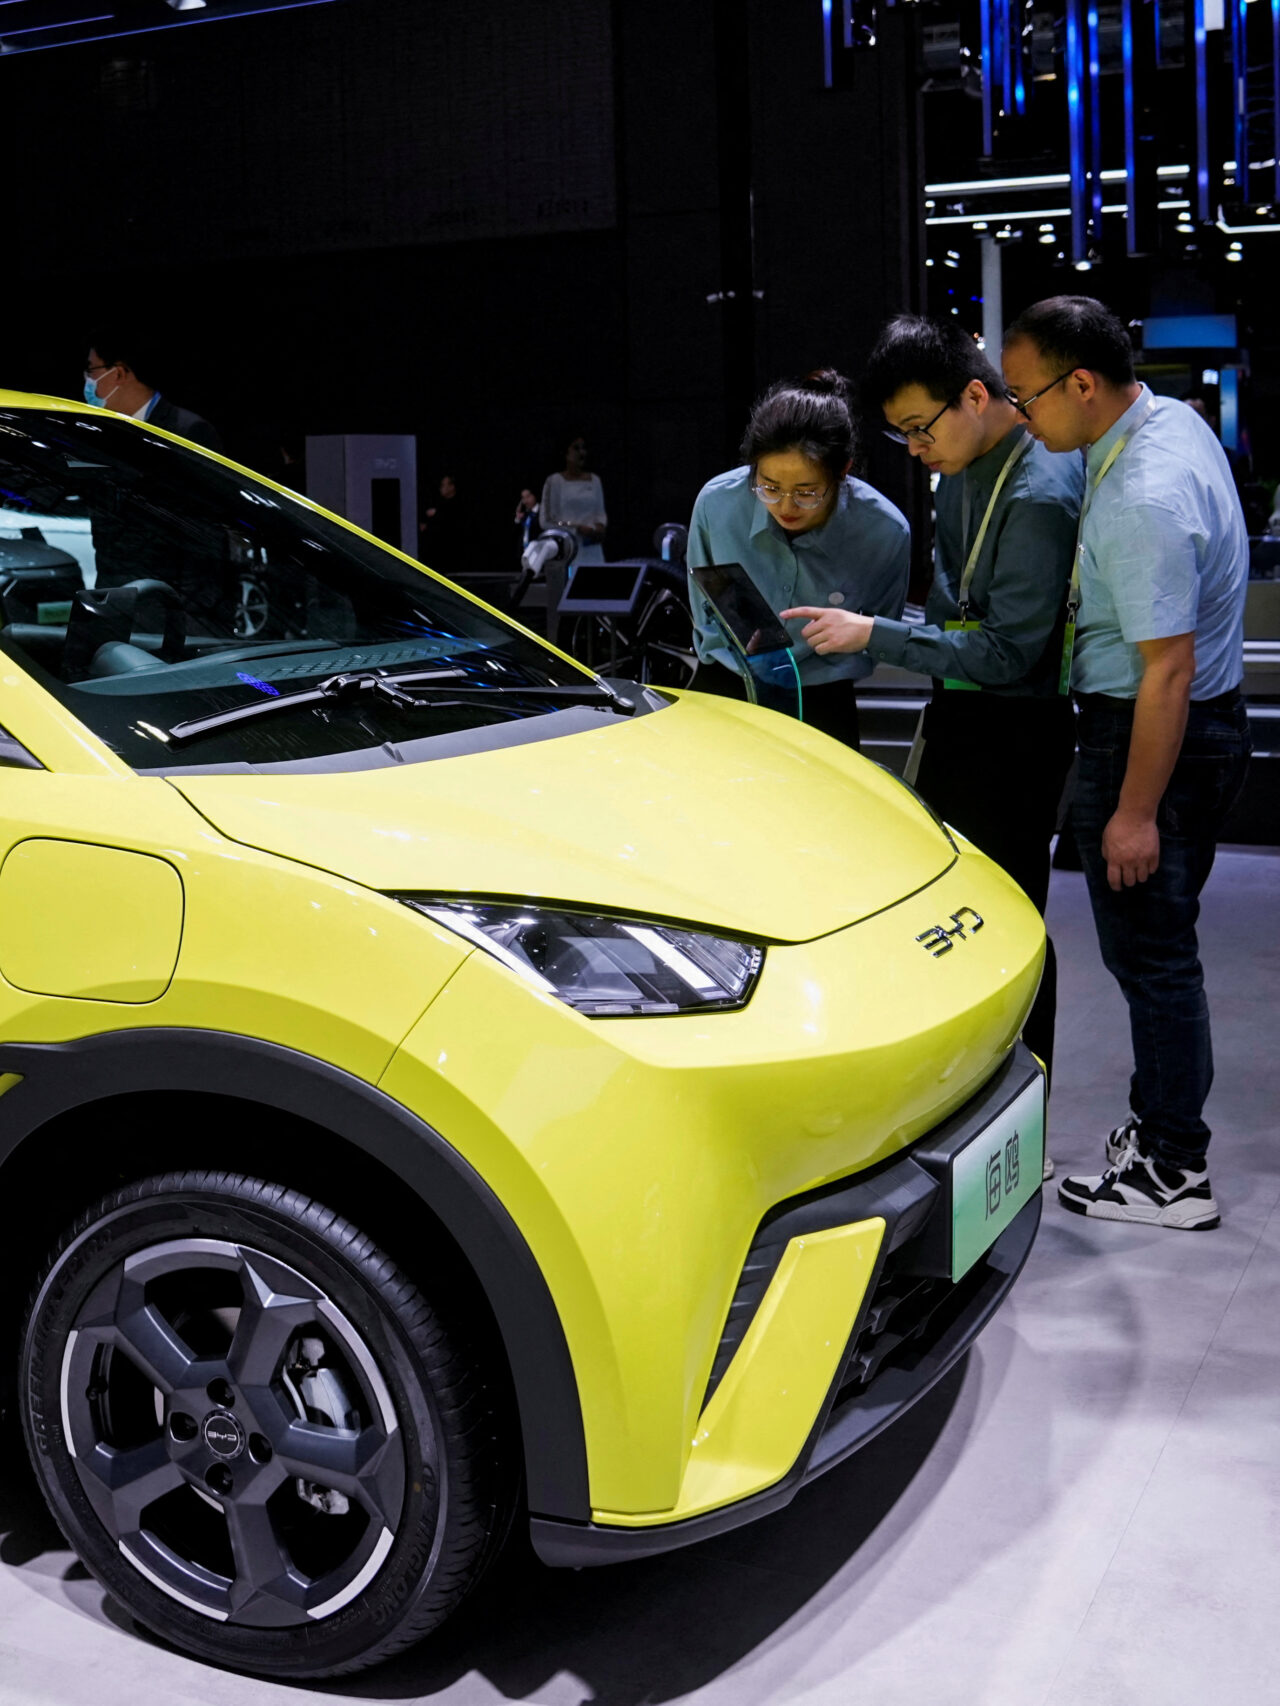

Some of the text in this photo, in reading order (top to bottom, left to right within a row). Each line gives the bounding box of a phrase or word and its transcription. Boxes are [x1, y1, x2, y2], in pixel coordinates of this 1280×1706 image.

[915, 907, 984, 958] BYD
[985, 1130, 1019, 1220] 海鸥
[207, 1430, 237, 1441] BYD
